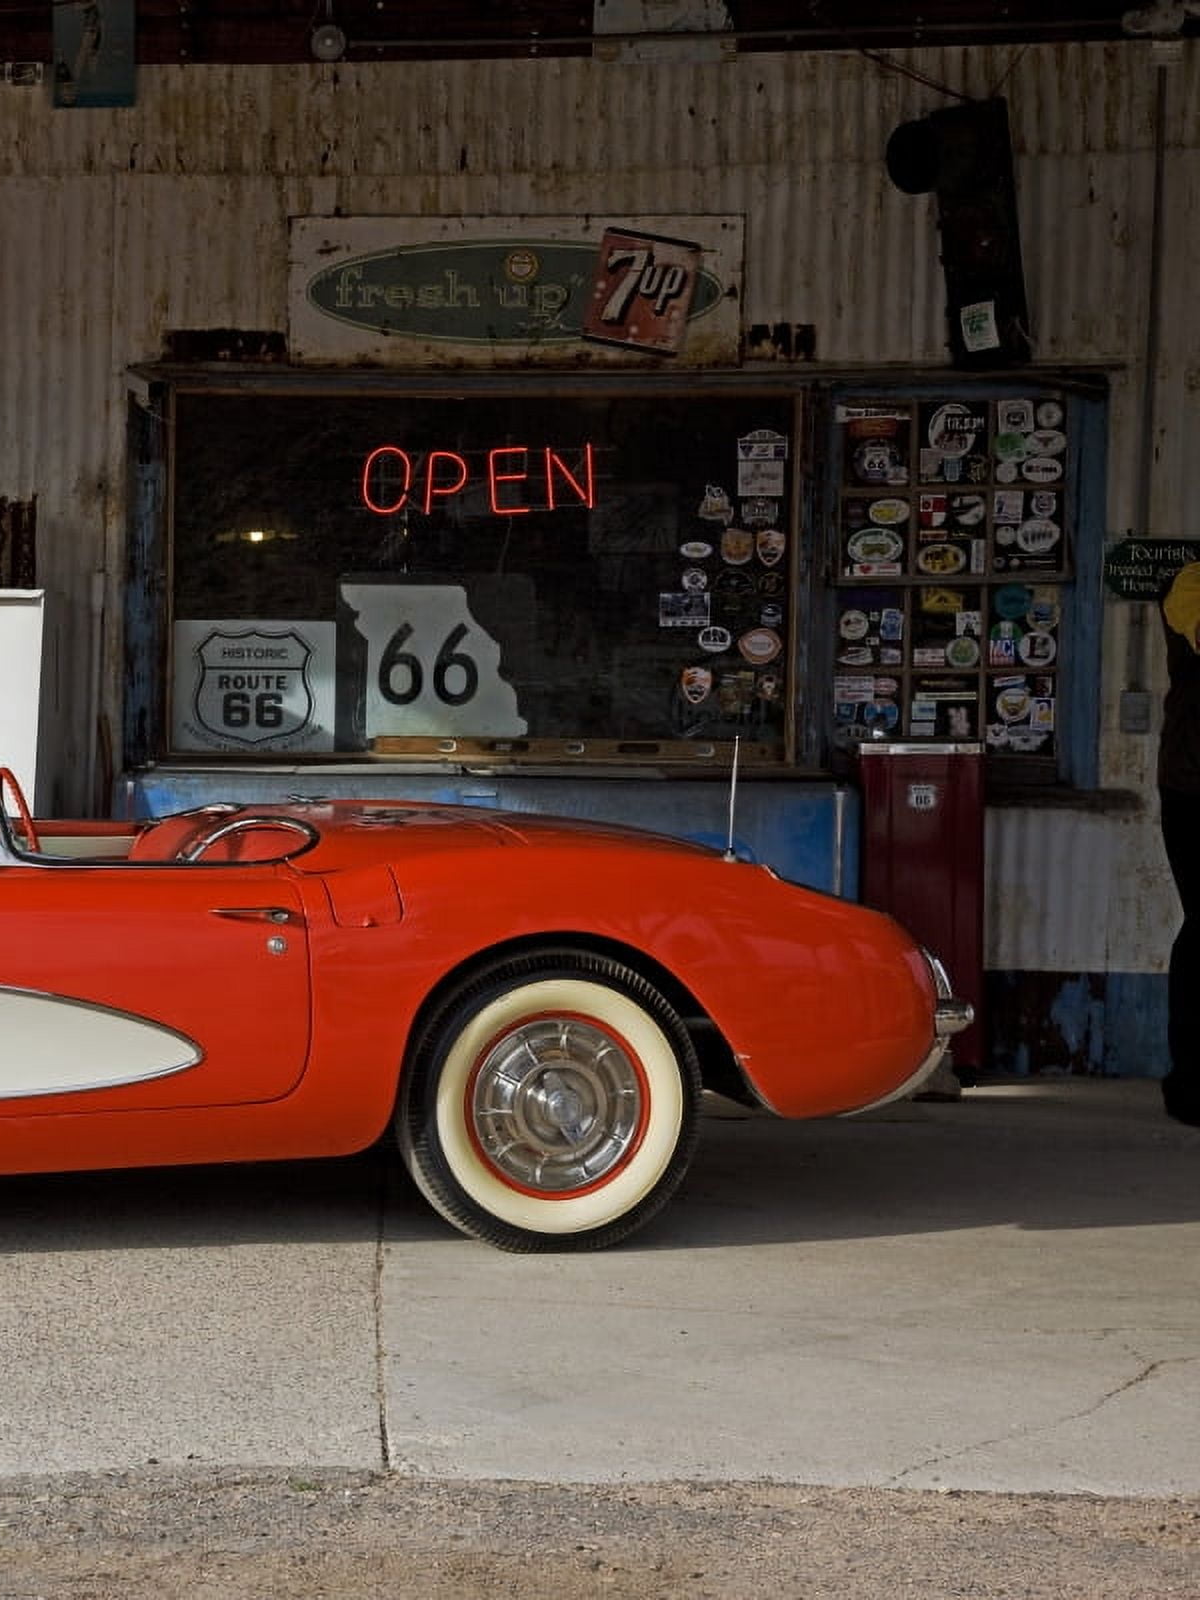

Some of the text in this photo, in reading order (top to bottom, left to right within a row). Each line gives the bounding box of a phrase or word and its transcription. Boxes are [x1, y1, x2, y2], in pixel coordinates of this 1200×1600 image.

[362, 441, 596, 516] OPEN
[221, 647, 289, 661] HISTORIC
[378, 622, 479, 707] 66
[218, 674, 288, 691] ROUTE
[222, 692, 284, 728] 66
